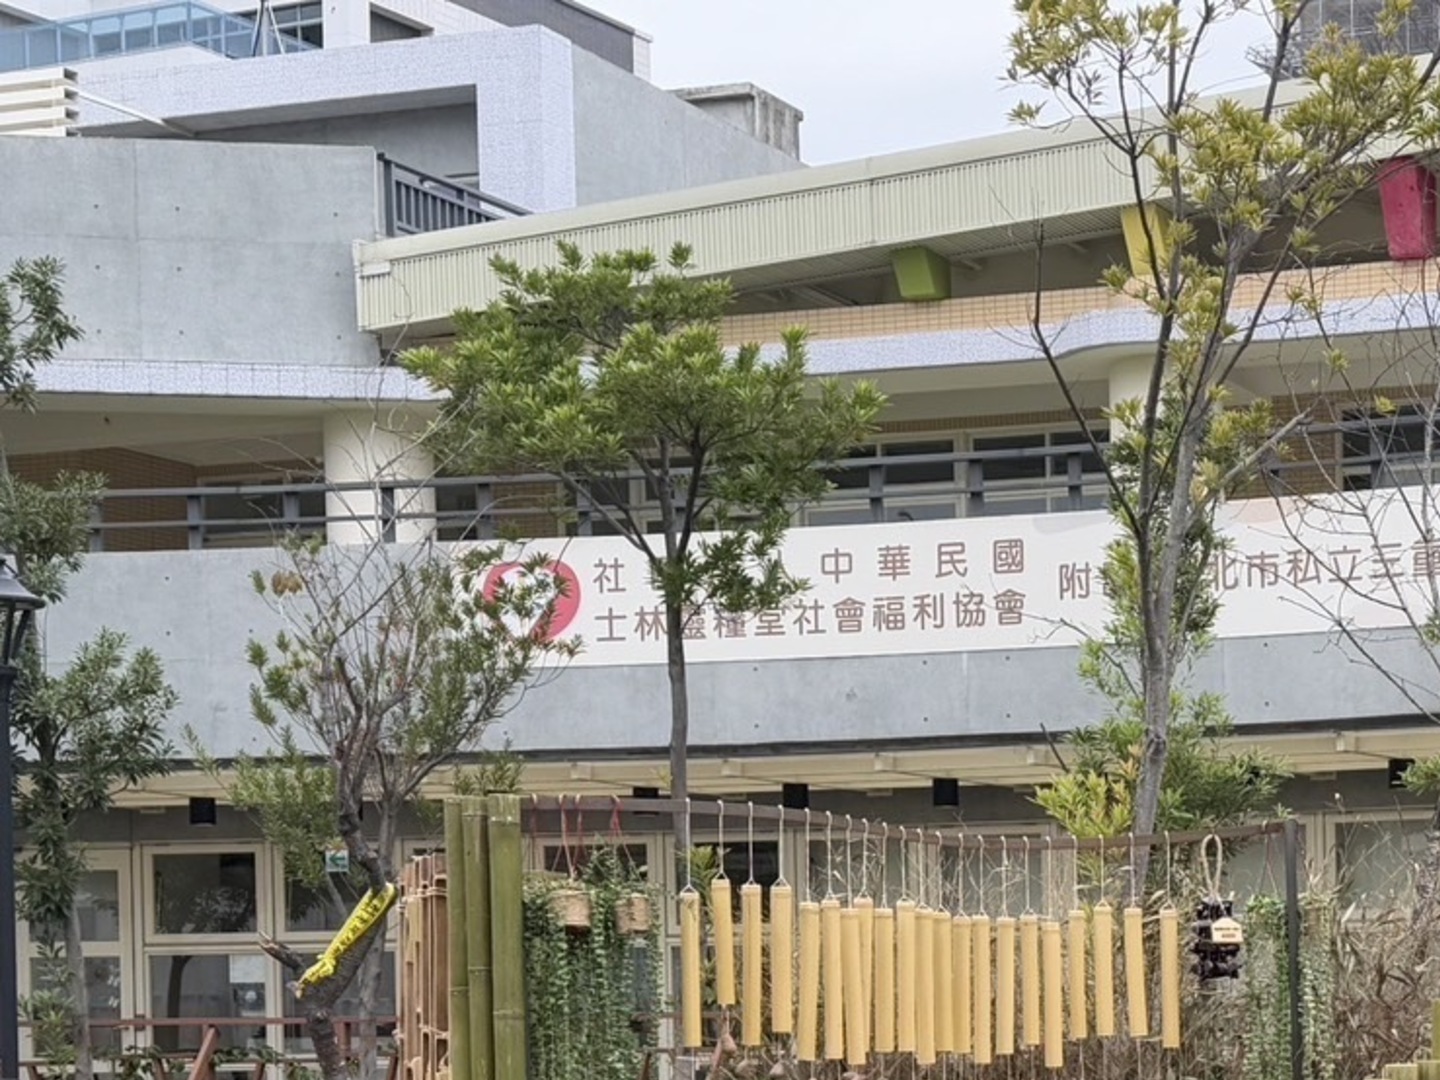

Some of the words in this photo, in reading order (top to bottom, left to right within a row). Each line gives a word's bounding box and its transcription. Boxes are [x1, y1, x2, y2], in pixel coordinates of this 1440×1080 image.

[592, 538, 1025, 594] 社中華民國
